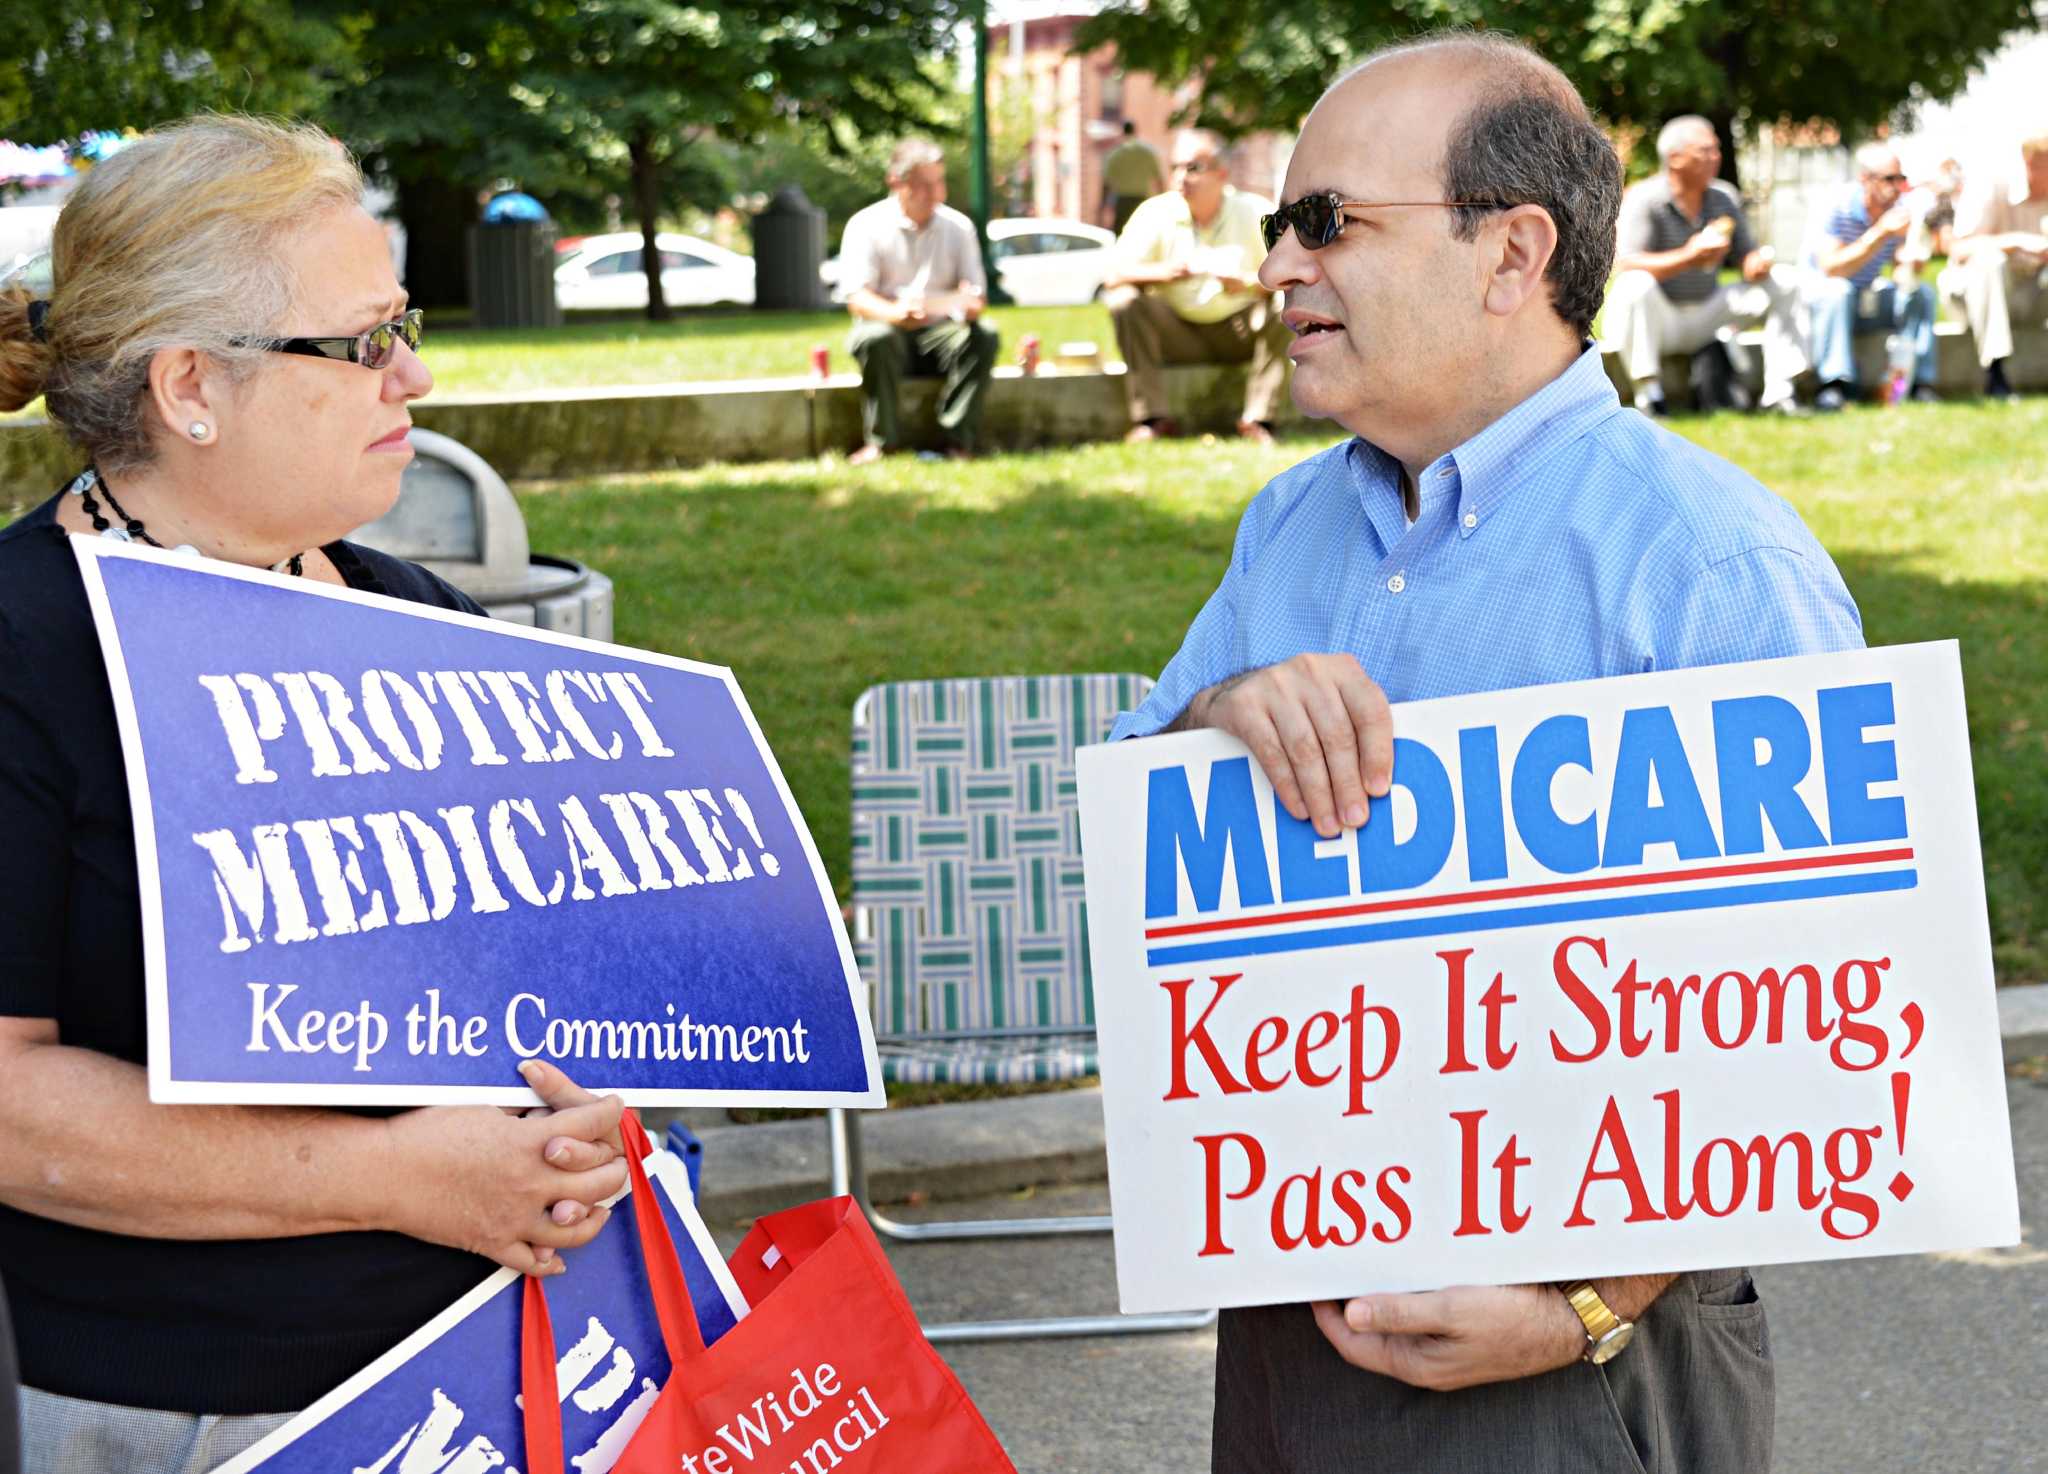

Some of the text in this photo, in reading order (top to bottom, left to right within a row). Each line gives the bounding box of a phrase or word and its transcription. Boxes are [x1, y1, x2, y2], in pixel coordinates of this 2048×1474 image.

[198, 669, 674, 784] PROTECT
[1145, 683, 1908, 919] MEDICARE
[192, 788, 780, 953] MEDICARE!
[246, 983, 810, 1072] Keep the Commitment
[1162, 936, 1924, 1116] Keep It Strong,
[1195, 1072, 1915, 1257] Pass It Along!
